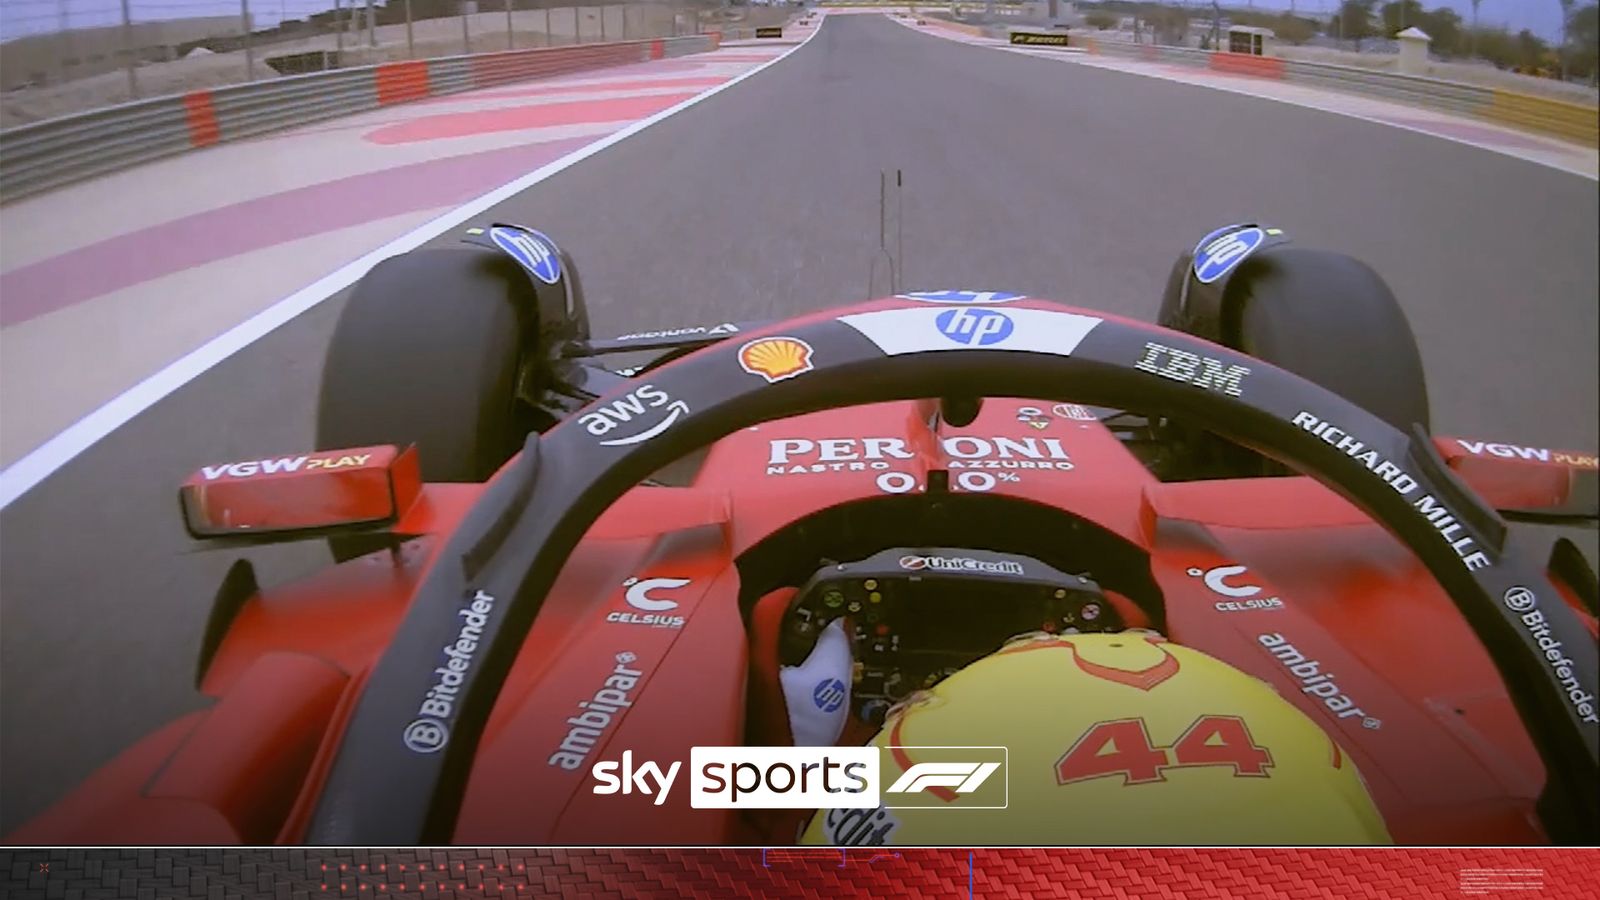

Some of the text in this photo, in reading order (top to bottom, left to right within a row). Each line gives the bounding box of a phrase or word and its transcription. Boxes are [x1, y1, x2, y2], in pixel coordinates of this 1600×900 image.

[944, 308, 1006, 346] hp
[1133, 341, 1251, 397] IBM
[577, 384, 669, 436] aws
[201, 454, 371, 480] VGW PLAY
[766, 459, 1075, 475] NASTRO AZZURRO
[1456, 439, 1549, 462] VGW
[1292, 411, 1491, 572] RICHARD MILLE
[926, 556, 1024, 575] UniCredit
[606, 612, 685, 627] CELSIUS
[1215, 597, 1283, 612] CELSIUS
[419, 589, 495, 719] Bitdefender
[1258, 632, 1365, 718] ambipar
[1521, 609, 1599, 724] Bitdefender
[547, 663, 643, 771] ambipar
[816, 678, 844, 712] hp
[1053, 714, 1276, 787] 44
